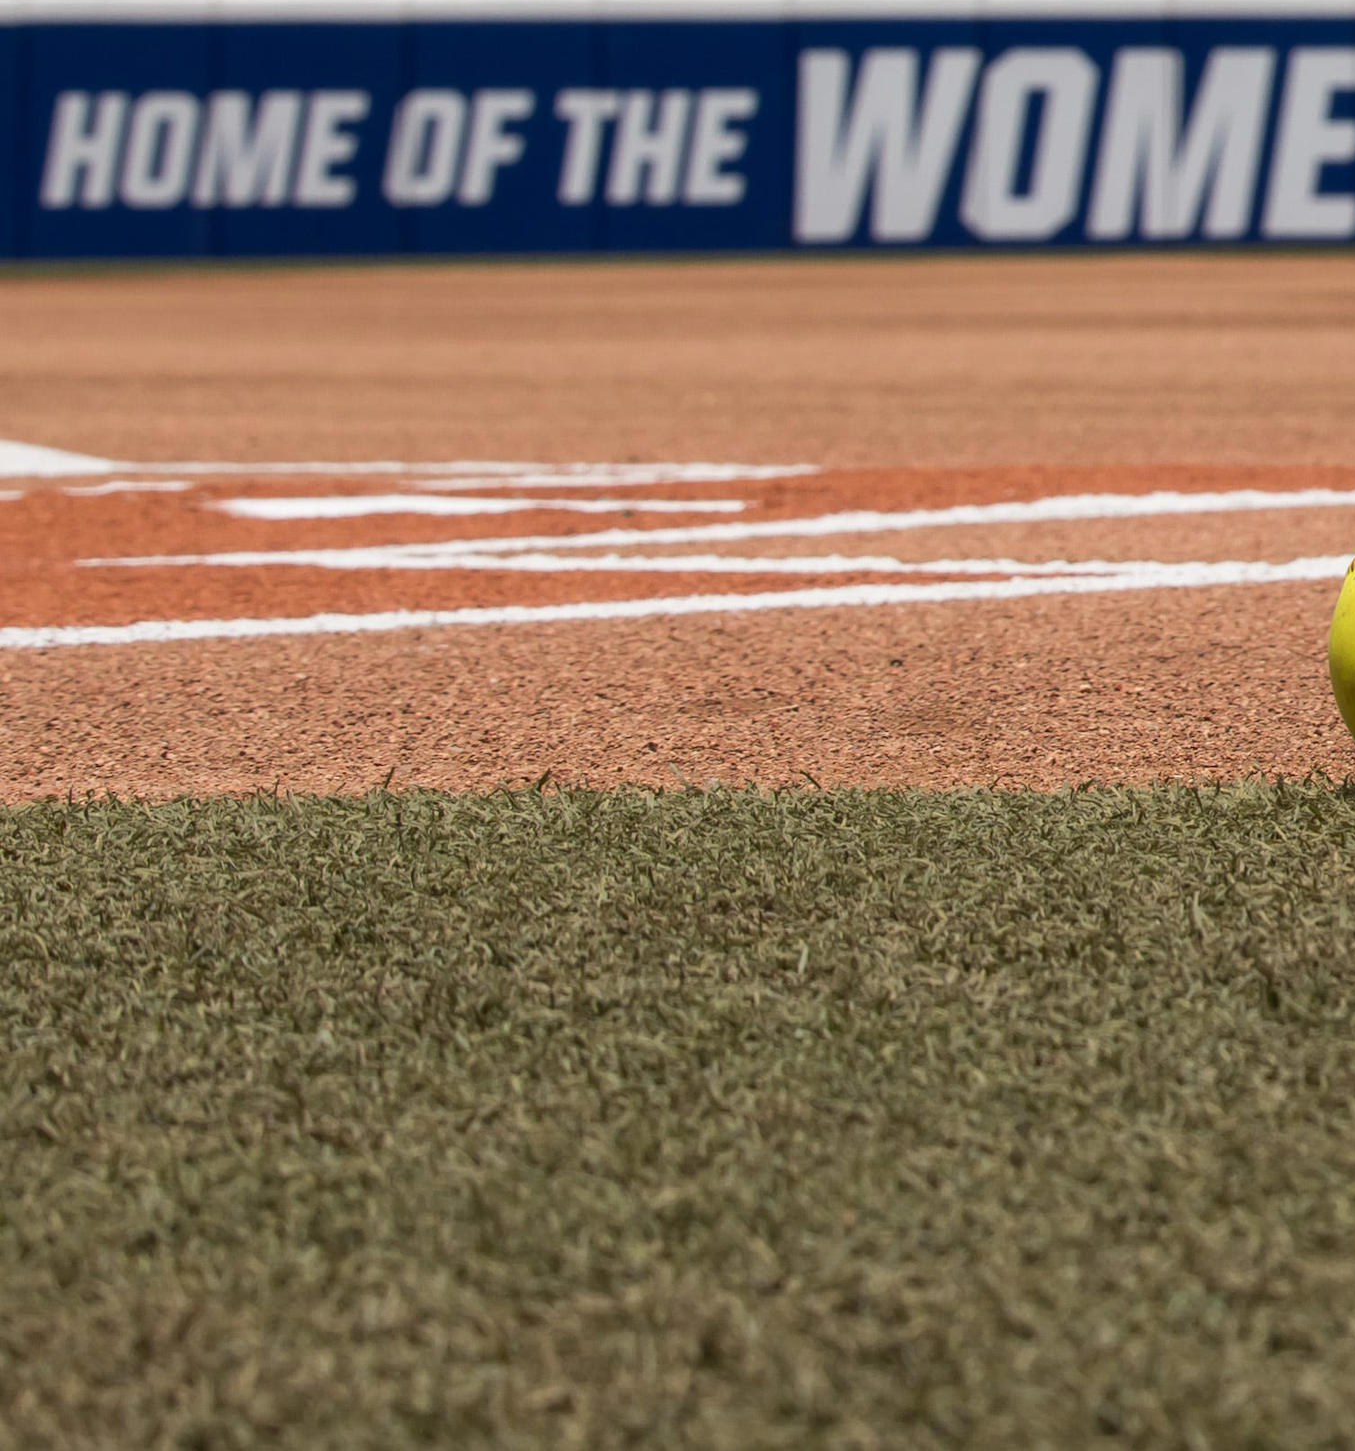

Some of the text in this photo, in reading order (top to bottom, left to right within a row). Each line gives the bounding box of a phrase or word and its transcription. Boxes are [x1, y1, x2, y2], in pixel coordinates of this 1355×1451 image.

[41, 90, 369, 208] HOME
[383, 89, 534, 206] OF
[555, 89, 757, 205] THE
